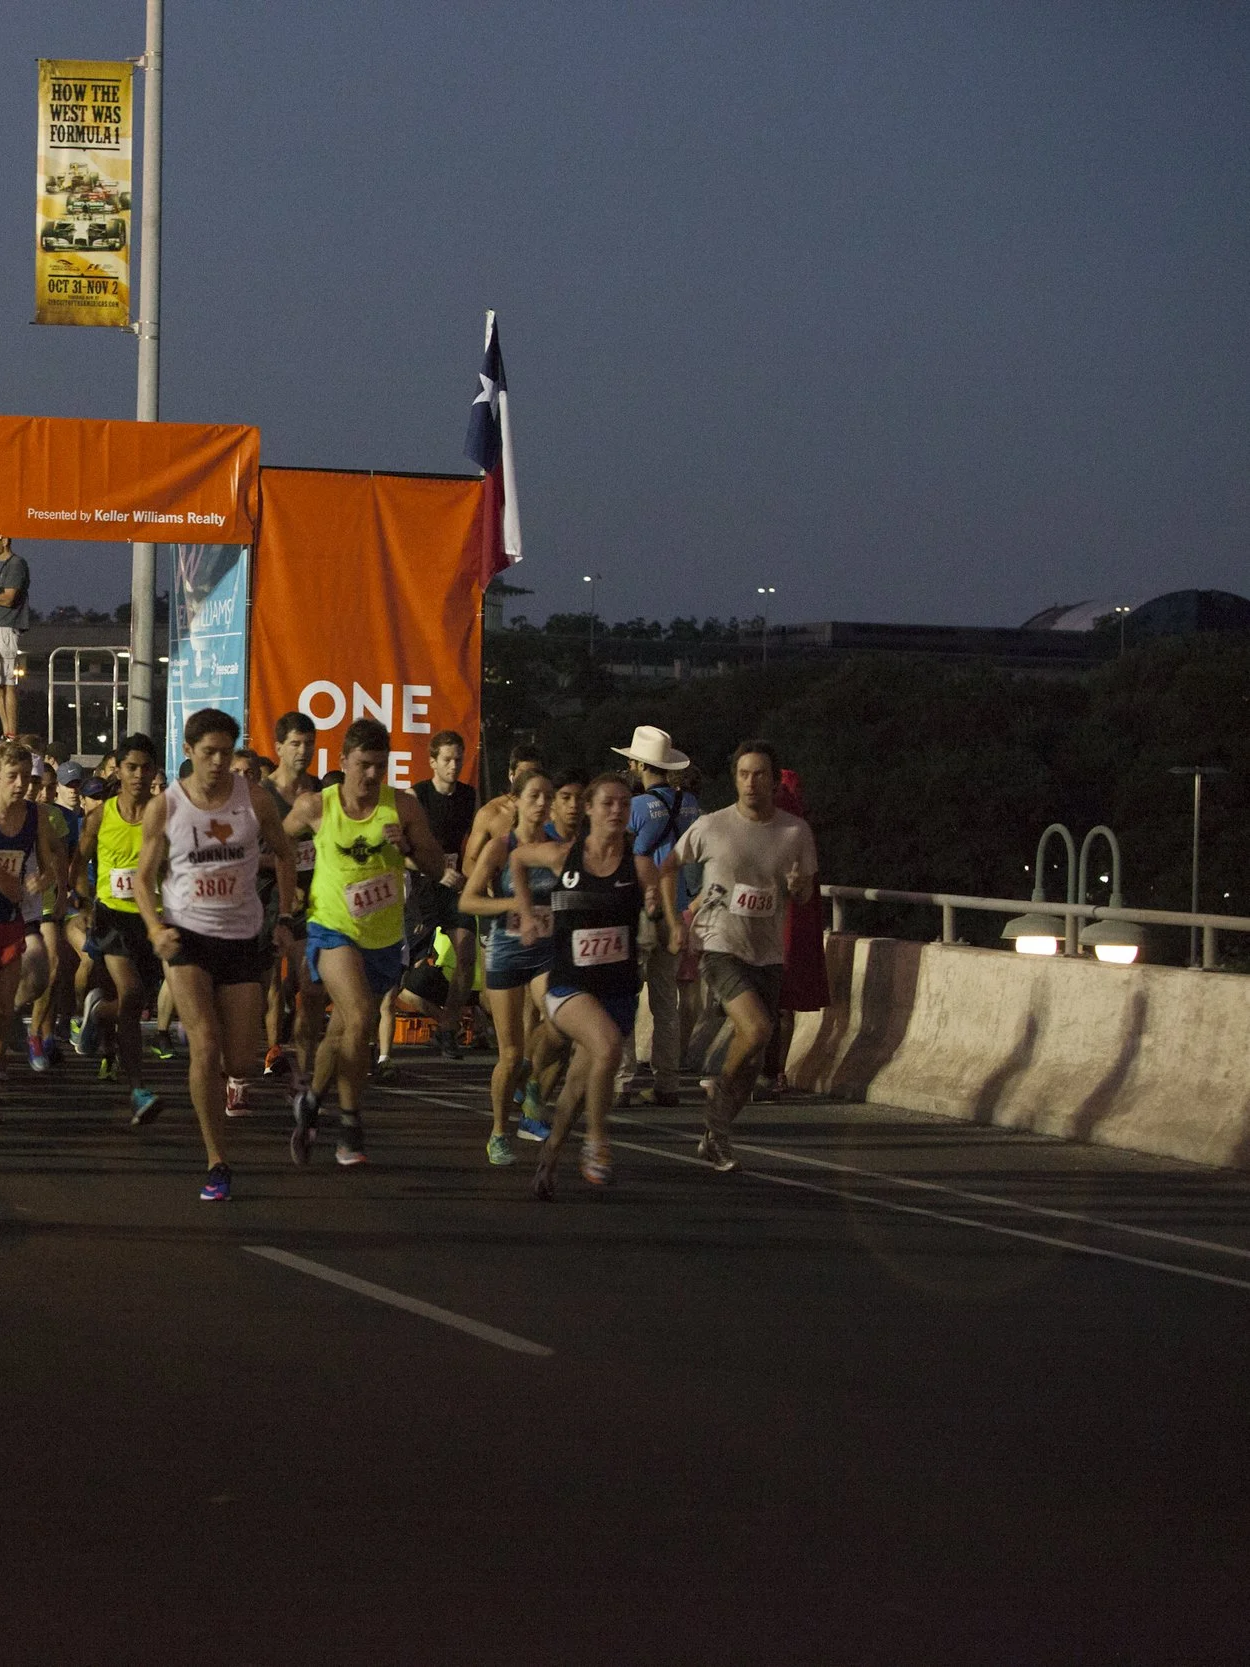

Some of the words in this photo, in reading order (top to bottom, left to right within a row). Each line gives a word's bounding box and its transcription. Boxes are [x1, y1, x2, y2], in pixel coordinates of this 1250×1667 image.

[51, 83, 87, 102] HOW
[91, 85, 120, 103] THE
[50, 104, 88, 123] WEST
[92, 105, 121, 124] WAS
[50, 124, 112, 144] FORMULA
[114, 126, 120, 145] 1
[48, 279, 70, 293] OCT
[112, 281, 119, 295] 2
[27, 507, 77, 521] Presented
[79, 509, 92, 523] by
[94, 509, 129, 523] Keller
[133, 510, 184, 524] Williams
[187, 512, 226, 527] Realty
[297, 679, 432, 734] ONE
[194, 876, 236, 897] 3807
[353, 882, 393, 908] 4111
[737, 892, 774, 911] 4038
[579, 936, 623, 957] 2774
